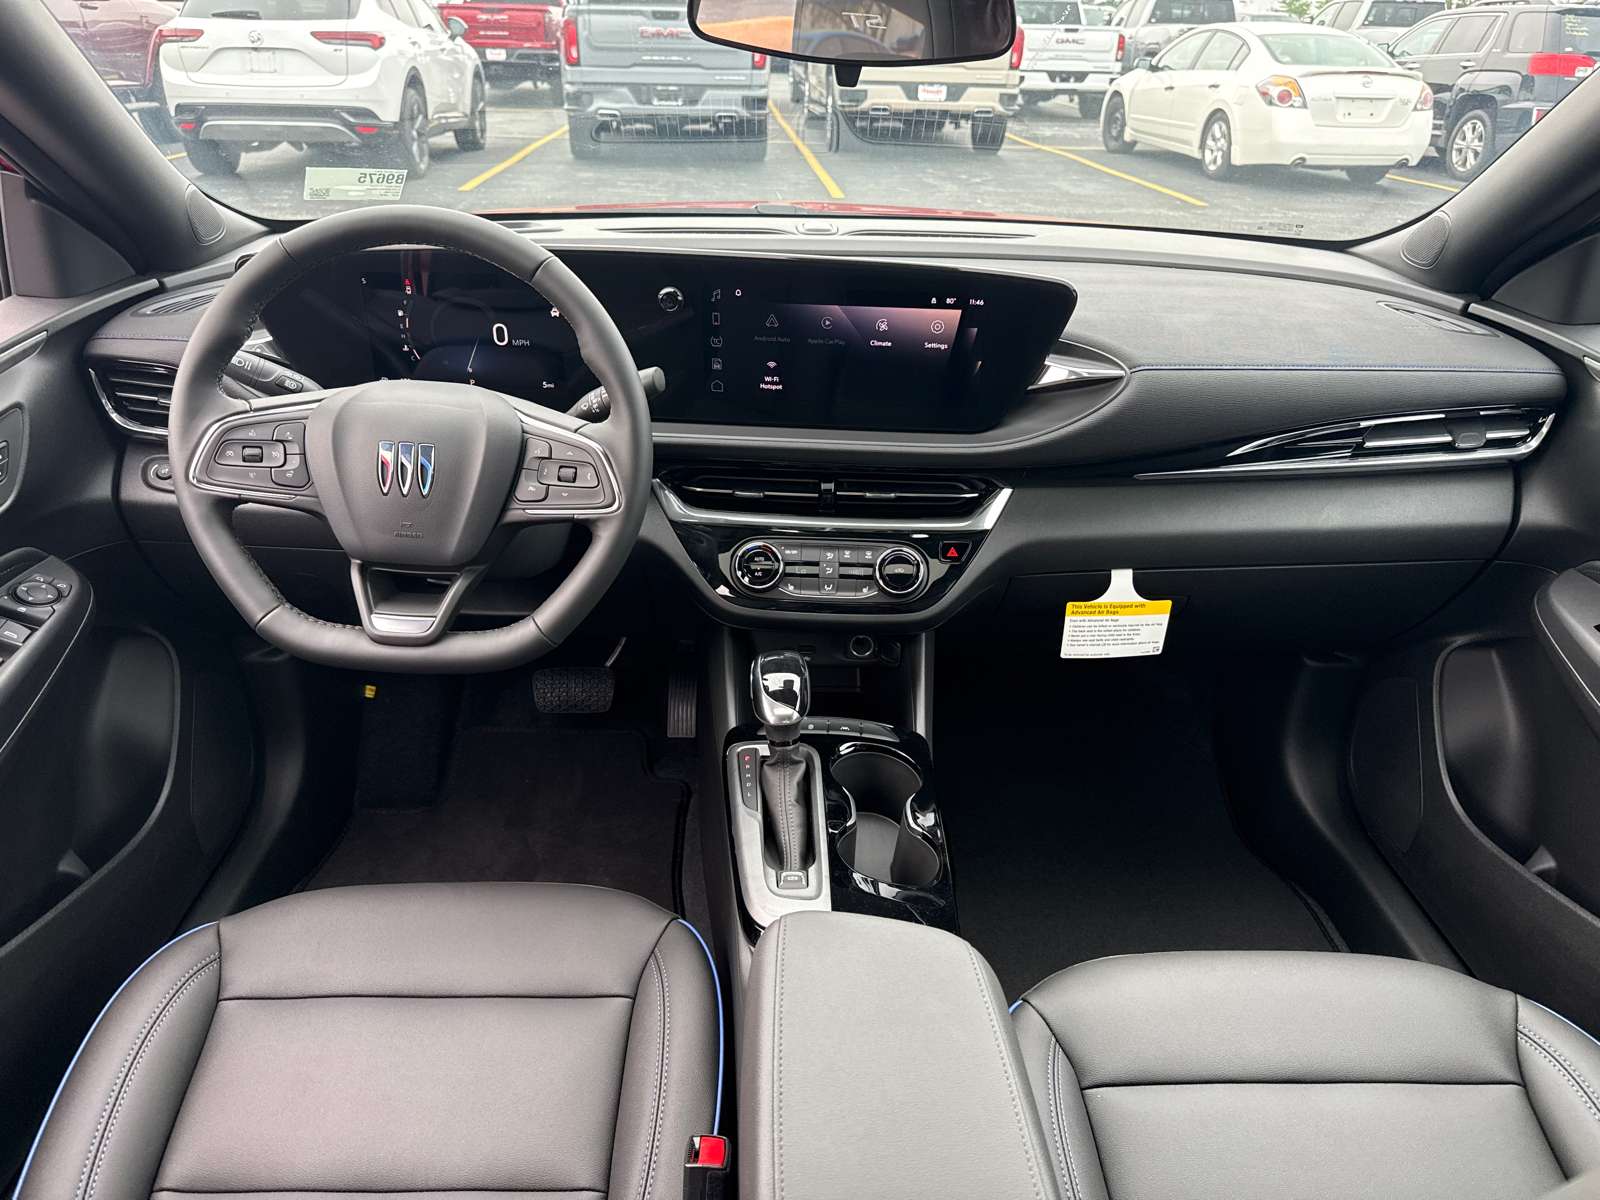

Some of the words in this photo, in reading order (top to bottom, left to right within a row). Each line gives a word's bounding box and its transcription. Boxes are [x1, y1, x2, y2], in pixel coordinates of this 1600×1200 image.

[638, 26, 692, 39] GMC
[1055, 37, 1086, 45] GMC
[492, 322, 509, 347] 0
[511, 339, 530, 347] MPH
[753, 335, 777, 343] Android
[807, 337, 824, 345] Apple
[824, 338, 846, 346] CarPlay
[924, 342, 948, 350] Settings
[759, 383, 783, 391] Hotspot
[393, 531, 425, 539] AIRBAG
